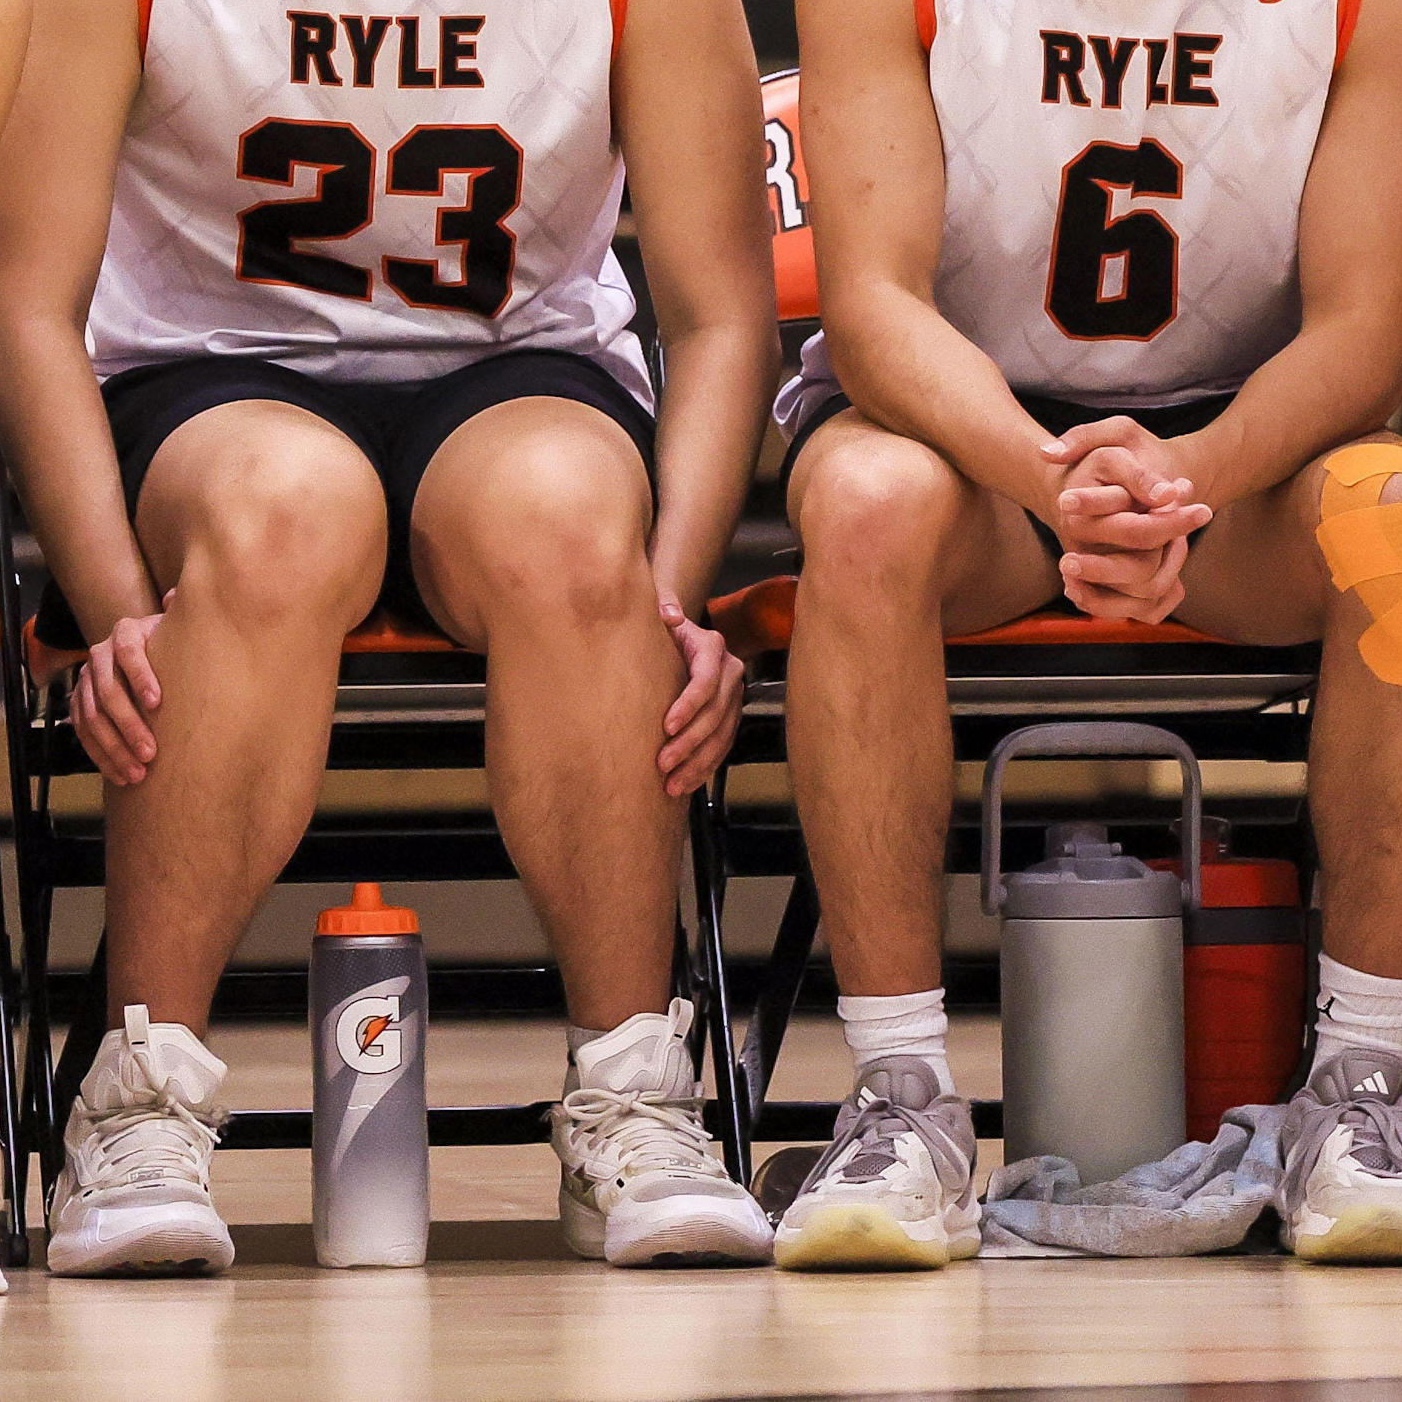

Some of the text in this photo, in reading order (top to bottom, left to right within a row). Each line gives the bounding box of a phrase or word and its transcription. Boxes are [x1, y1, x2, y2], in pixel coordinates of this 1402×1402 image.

[286, 9, 486, 89] RYLE
[1039, 29, 1223, 110] RYLE
[236, 116, 524, 319] 23
[1044, 137, 1184, 342] 6
[335, 994, 402, 1075] G
